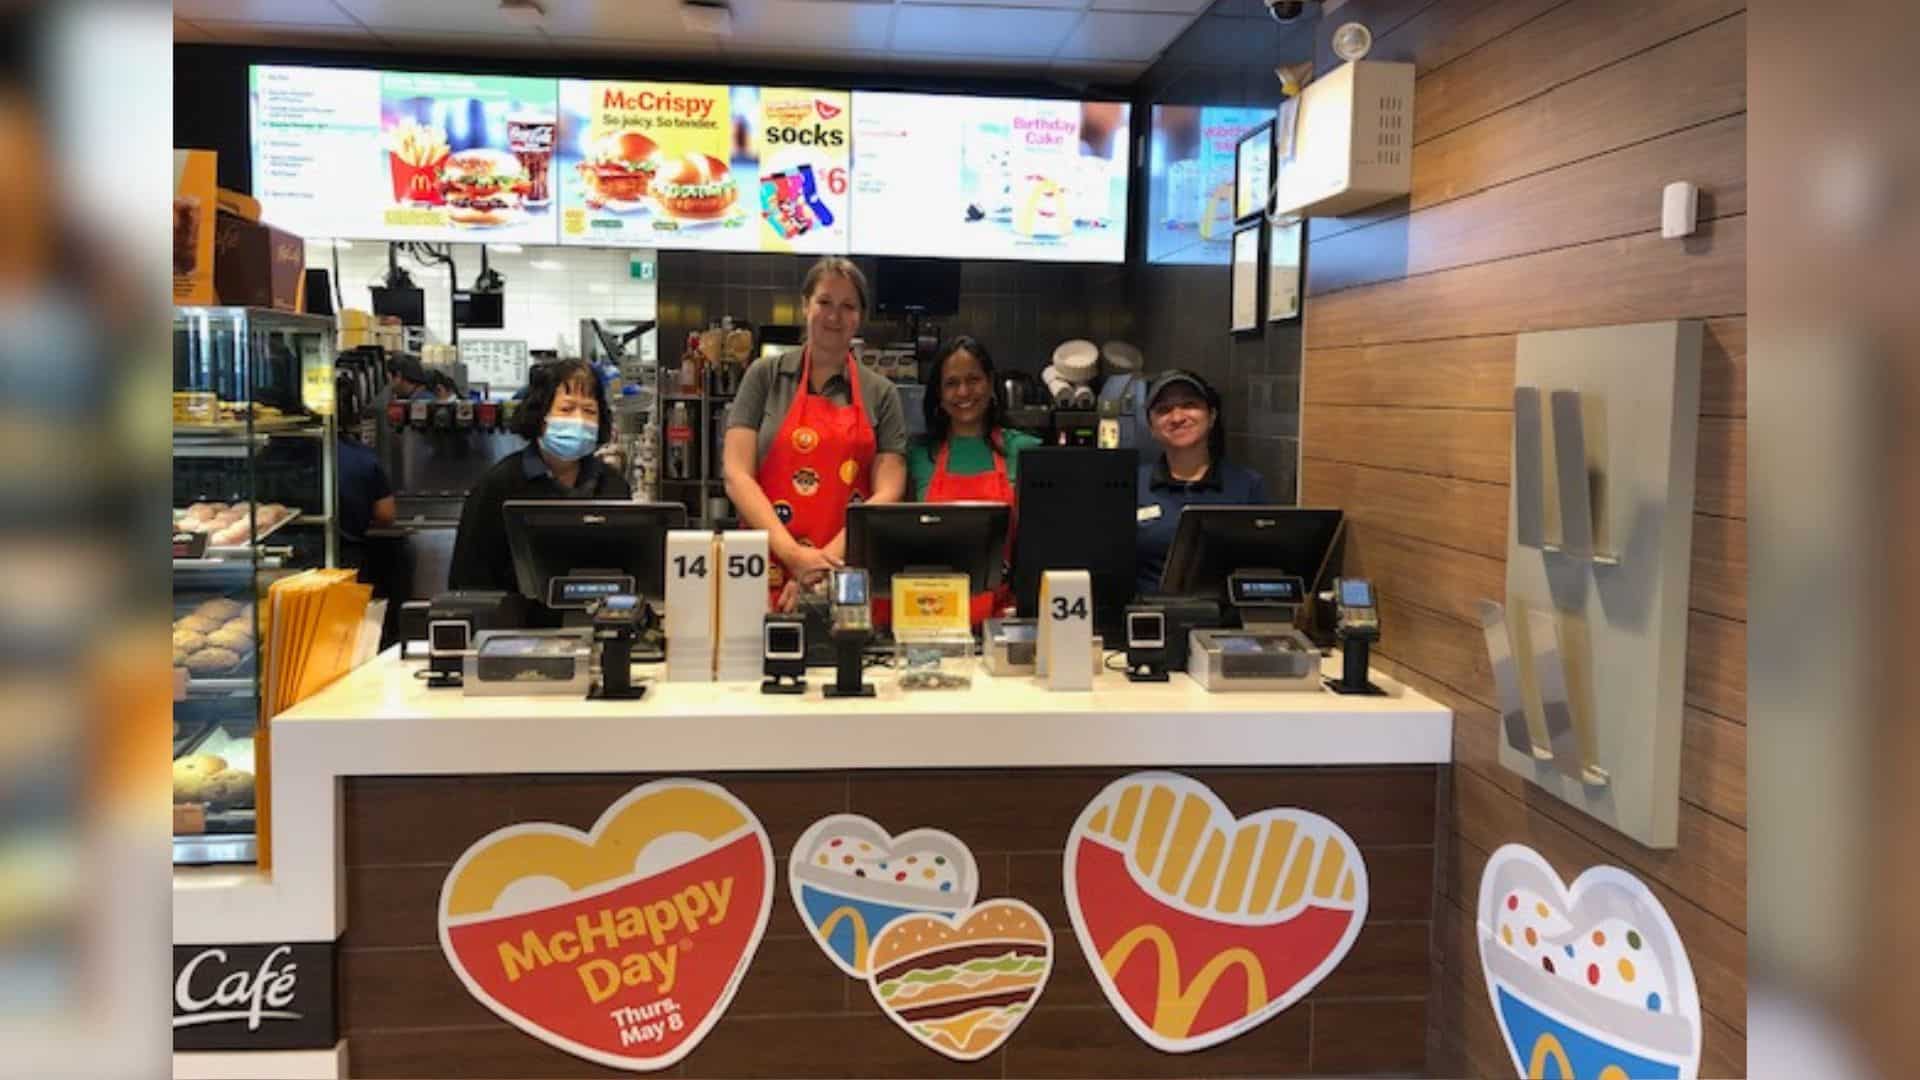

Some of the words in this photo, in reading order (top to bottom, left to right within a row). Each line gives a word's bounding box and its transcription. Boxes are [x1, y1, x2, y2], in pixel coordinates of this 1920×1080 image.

[603, 88, 715, 118] McCrispy
[603, 114, 619, 125] So
[656, 116, 673, 127] So
[1013, 116, 1076, 135] Birthday
[766, 123, 843, 146] socks
[1025, 131, 1064, 145] Cake
[673, 555, 708, 578] 14
[727, 555, 765, 578] 50
[1051, 597, 1088, 620] 34
[498, 876, 734, 983] McHappy
[577, 943, 678, 1004] Day
[175, 945, 298, 1031] Café
[610, 998, 681, 1028] Thurs.
[620, 1020, 665, 1047] May
[667, 1012, 684, 1031] 8
